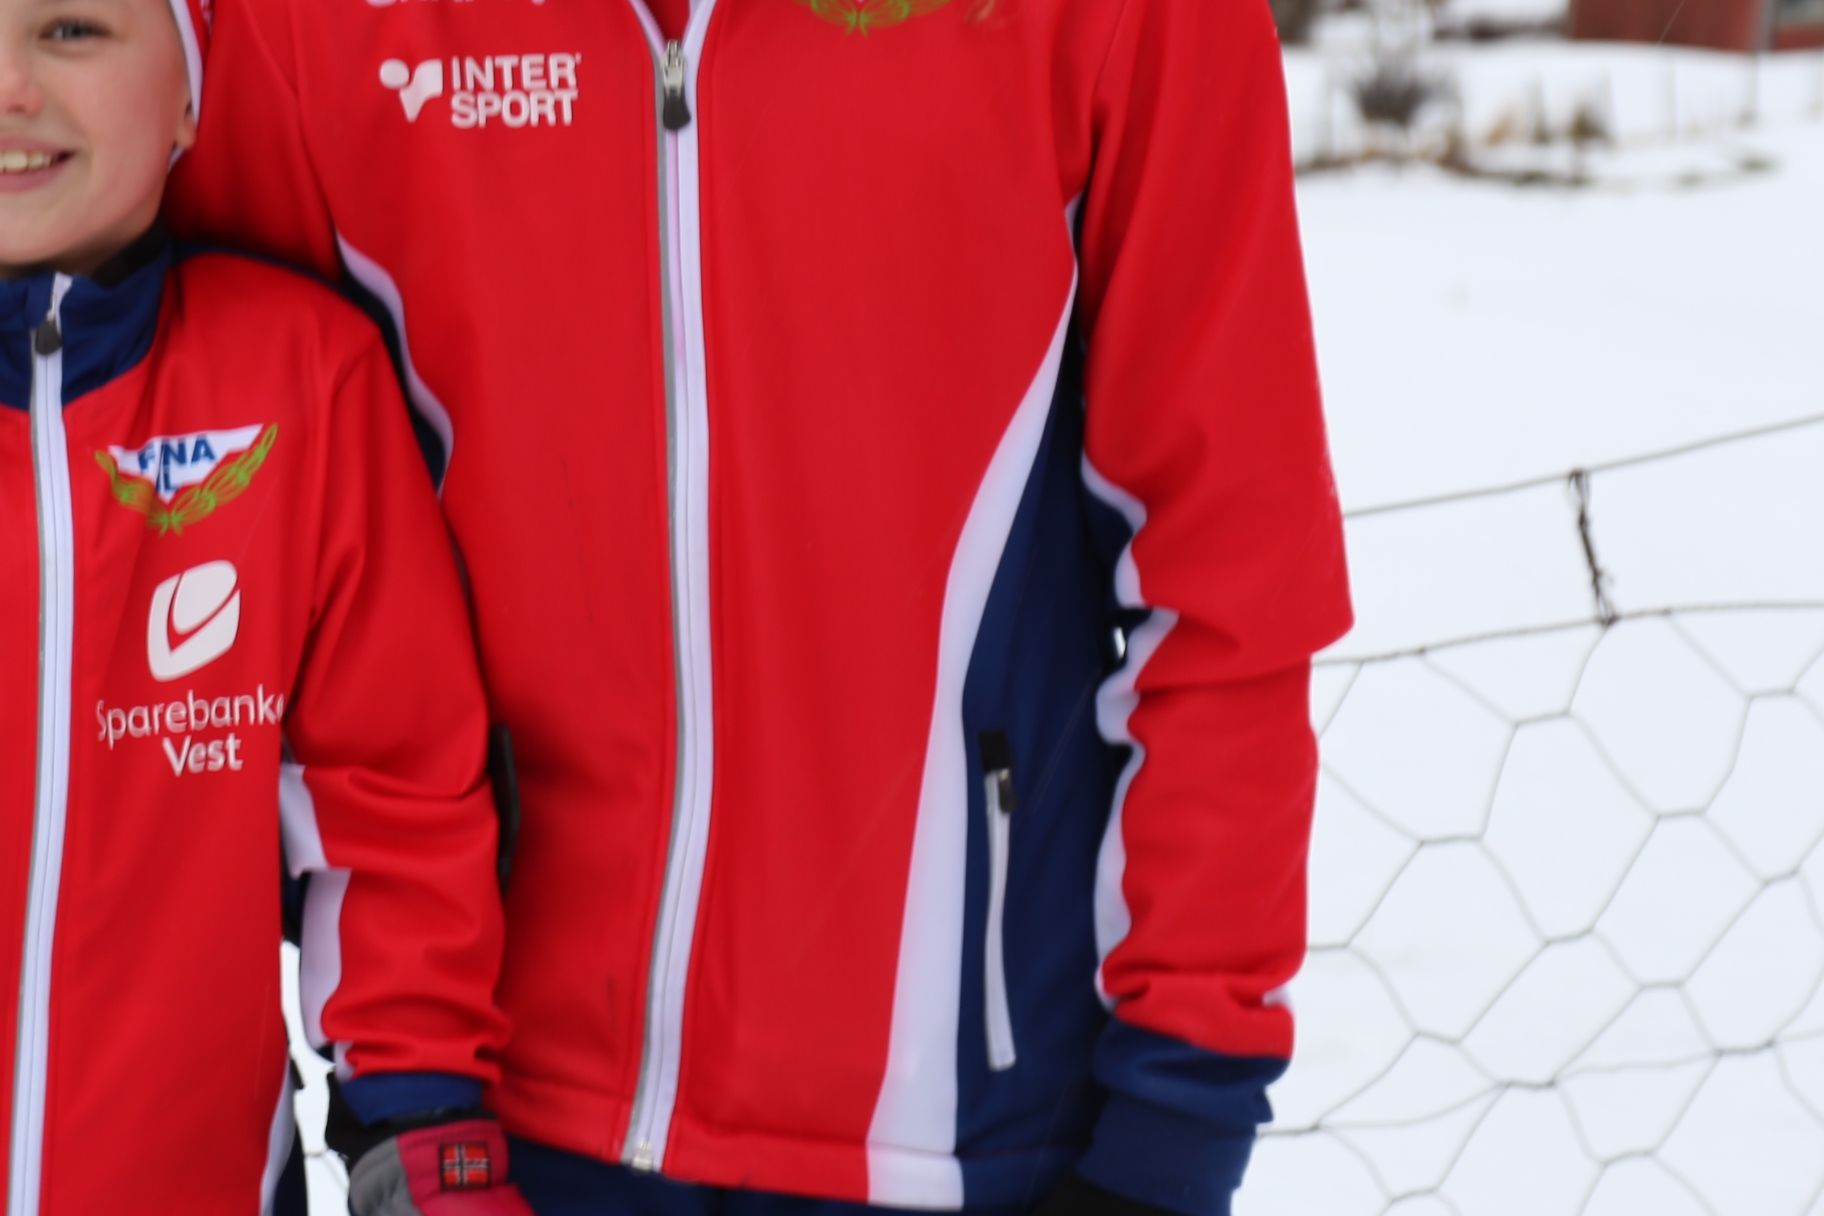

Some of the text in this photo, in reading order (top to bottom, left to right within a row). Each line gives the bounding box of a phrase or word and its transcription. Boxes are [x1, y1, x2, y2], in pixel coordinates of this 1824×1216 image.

[451, 52, 577, 91] INTER
[451, 88, 579, 130] SPORT
[162, 733, 244, 778] Vest
